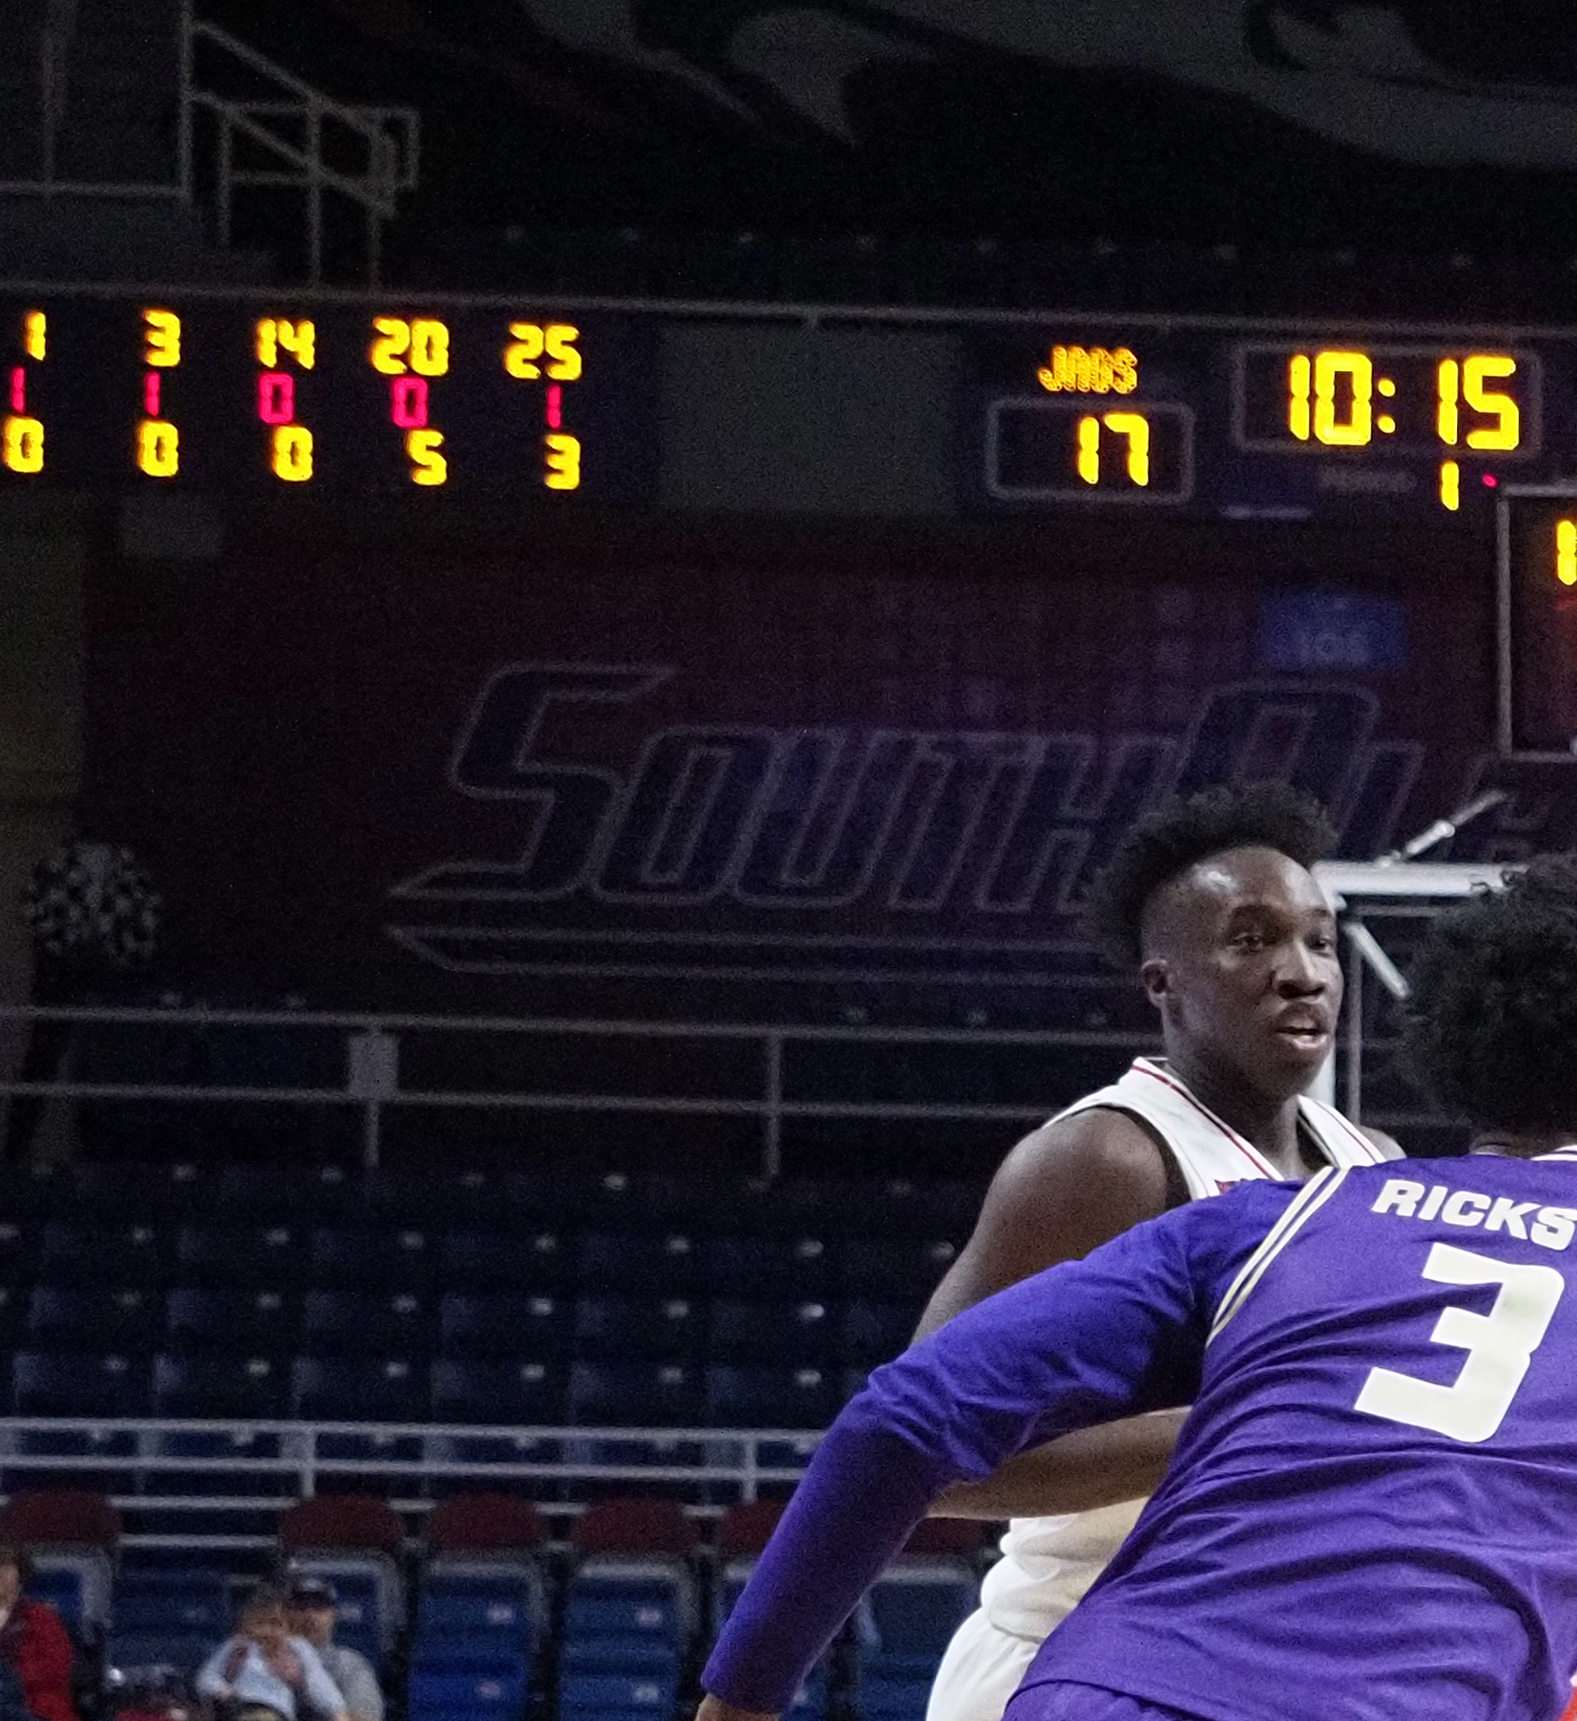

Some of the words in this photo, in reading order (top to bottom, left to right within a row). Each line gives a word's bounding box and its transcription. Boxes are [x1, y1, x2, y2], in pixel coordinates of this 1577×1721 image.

[26, 312, 46, 361] 1
[145, 310, 180, 367] 3
[257, 319, 315, 370] 14
[371, 317, 449, 377] 20
[504, 323, 581, 381] 25
[11, 368, 25, 413] 1
[145, 373, 160, 417] 1
[259, 374, 294, 424] 0
[392, 376, 427, 428] 0
[547, 386, 561, 429] 1
[3, 416, 44, 473] 0
[138, 420, 178, 477] 0
[272, 425, 313, 481] 0
[406, 429, 447, 486] 5
[545, 434, 580, 489] 3
[1077, 413, 1149, 486] 17
[1440, 461, 1459, 510] 1
[1354, 1241, 1565, 1443] 3
